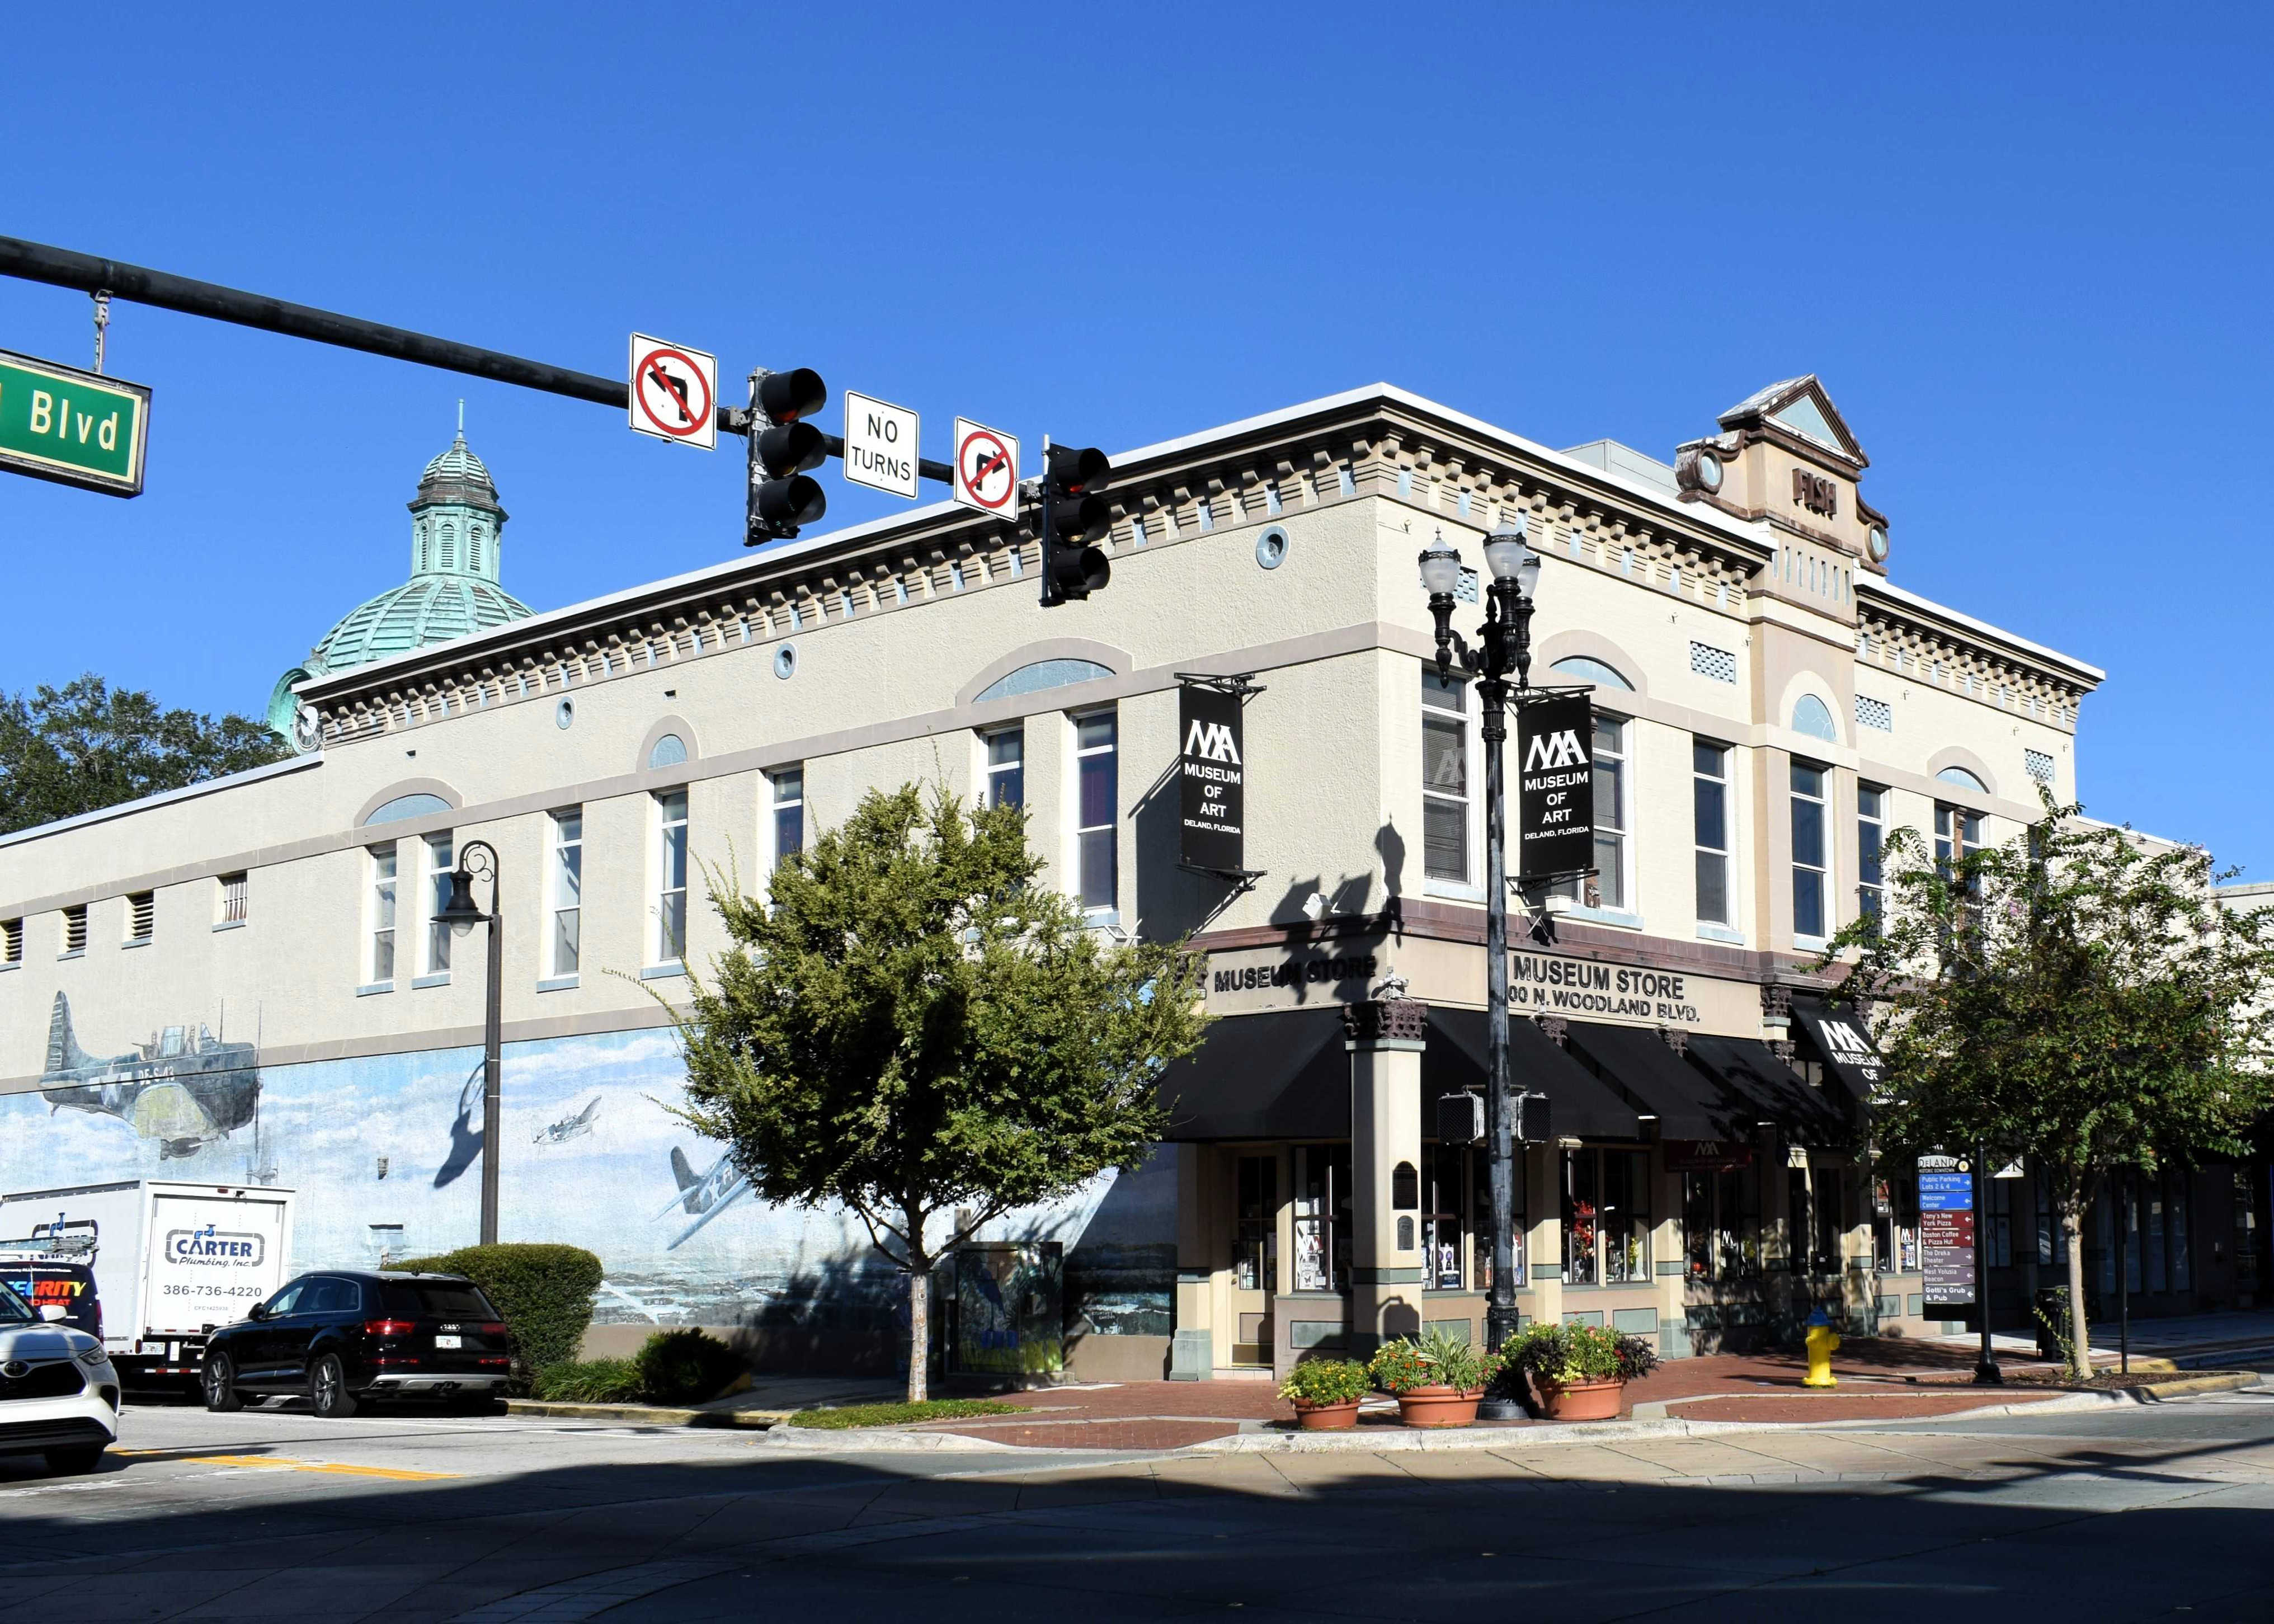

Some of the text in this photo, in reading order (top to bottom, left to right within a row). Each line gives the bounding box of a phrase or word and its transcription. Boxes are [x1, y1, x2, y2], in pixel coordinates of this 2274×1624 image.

[30, 390, 117, 450] Blvd
[868, 413, 898, 443] NO
[852, 446, 910, 481] TURNS
[1185, 762, 1241, 784] MUSEUM
[1525, 771, 1588, 792] MUSEUM
[1204, 785, 1223, 799] OF
[1547, 792, 1567, 806] OF
[1200, 803, 1226, 817] ART
[1542, 809, 1572, 824] ART
[1184, 819, 1241, 834] DELAND, FLORIDA
[1524, 826, 1589, 840] DELAND, FLORIDA
[1214, 955, 1376, 992] MUSEUM STORE
[1513, 955, 1684, 1000] MUSEUM STORE
[1508, 985, 1701, 1022] 00 N. WOODLAND BLVD.
[1832, 1052, 1885, 1067] MUSEUM
[1862, 1068, 1878, 1080] OF
[177, 1239, 252, 1257] CARTER
[8, 1281, 87, 1297] EGRITY
[163, 1286, 262, 1296] 386-736-4220
